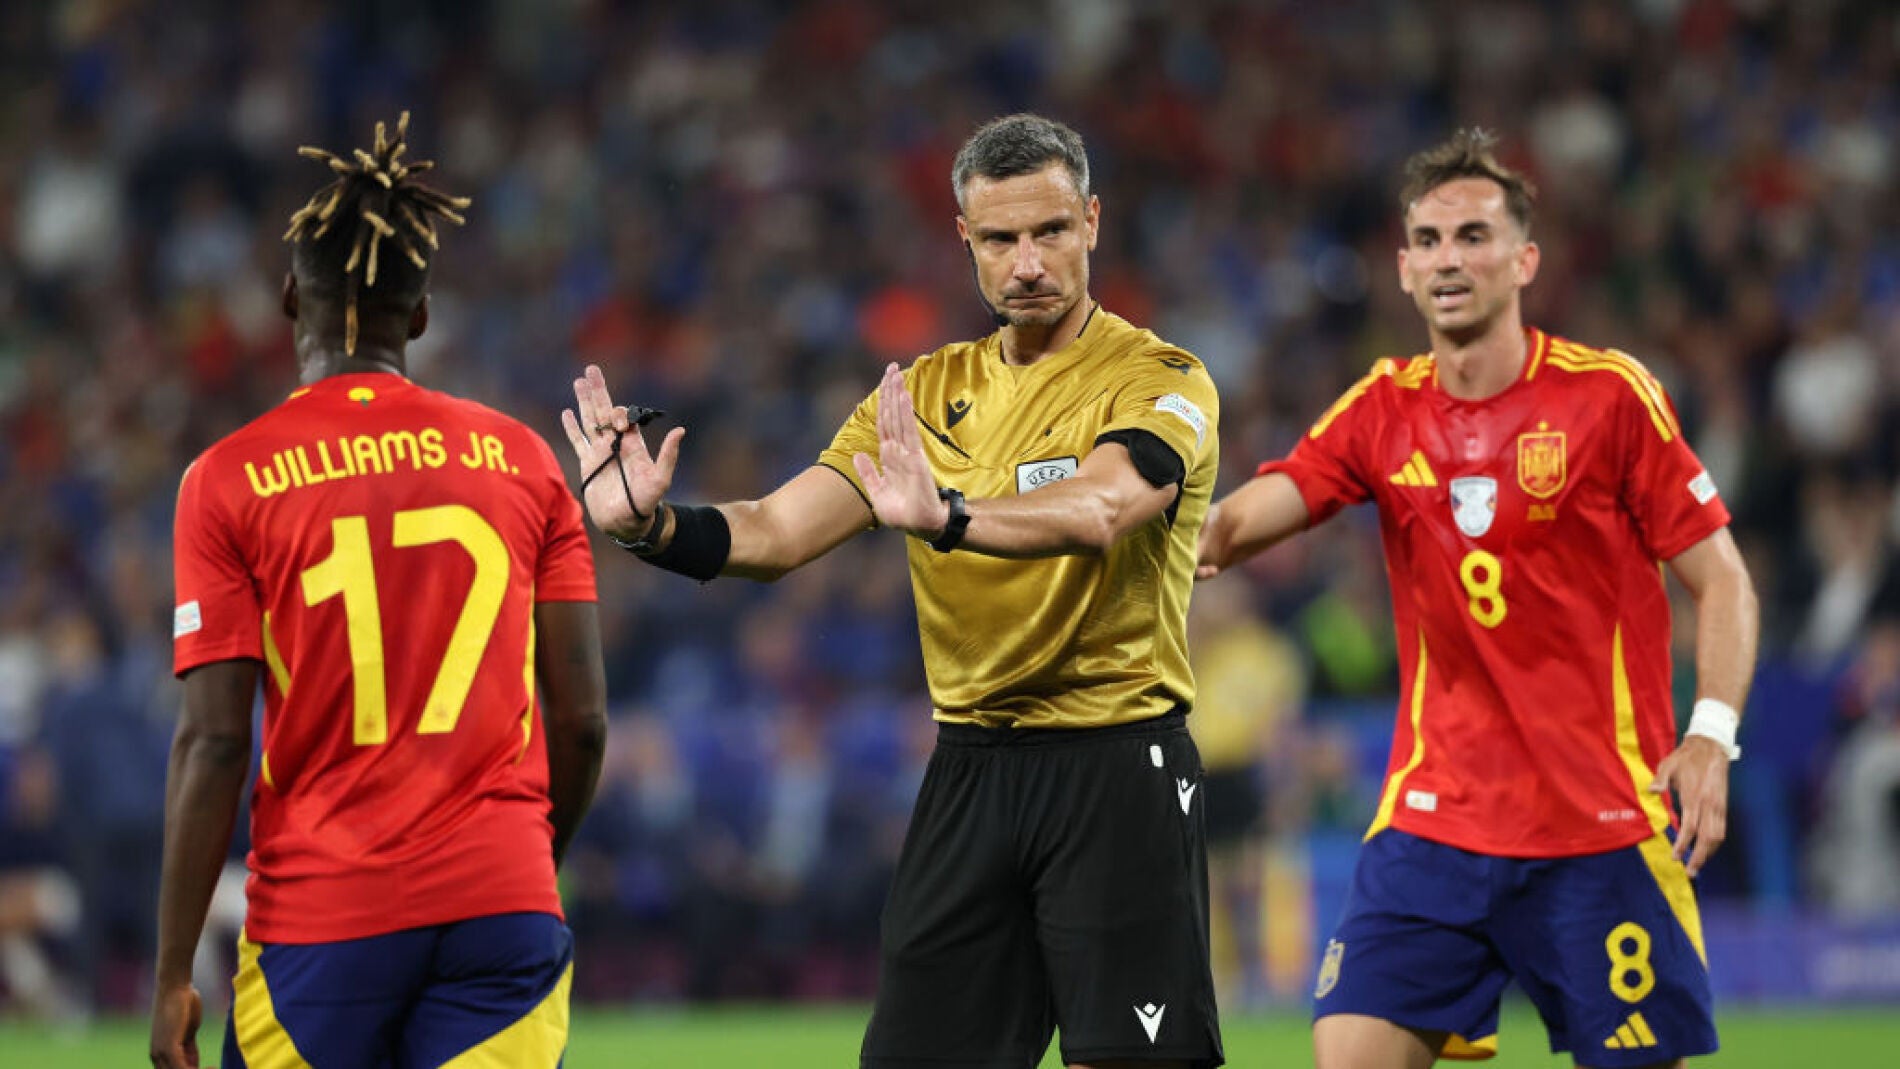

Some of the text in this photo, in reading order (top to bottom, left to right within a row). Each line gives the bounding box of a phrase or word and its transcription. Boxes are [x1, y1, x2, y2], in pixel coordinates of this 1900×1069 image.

[244, 427, 520, 498] WILLIAMS JR.
[1030, 469, 1064, 485] UEFA
[300, 504, 511, 746] 17
[1460, 549, 1508, 629] 8
[1605, 921, 1656, 1004] 8
